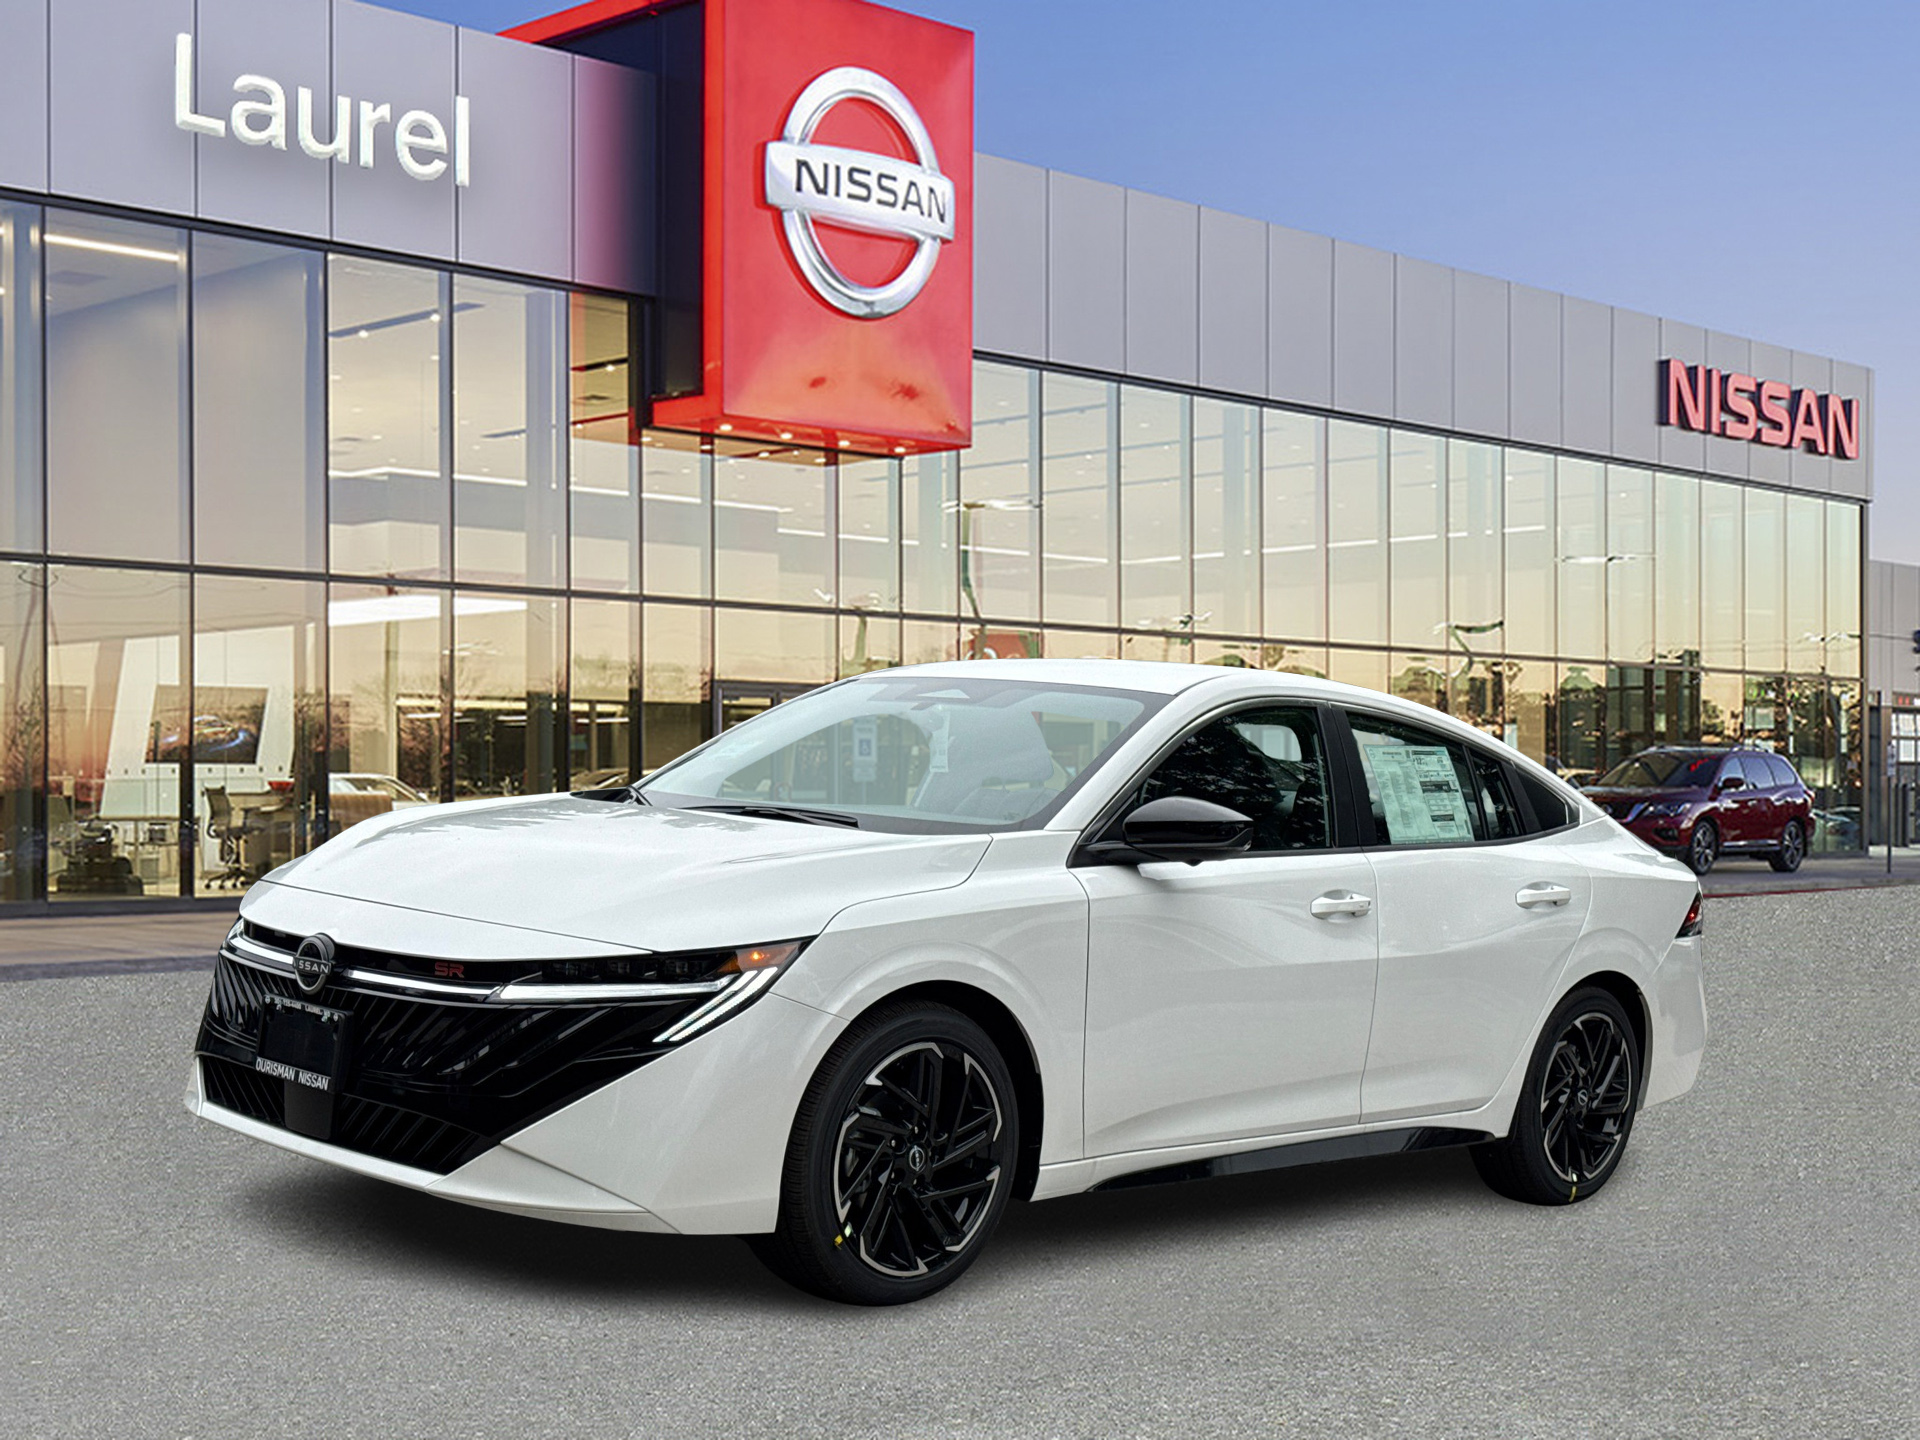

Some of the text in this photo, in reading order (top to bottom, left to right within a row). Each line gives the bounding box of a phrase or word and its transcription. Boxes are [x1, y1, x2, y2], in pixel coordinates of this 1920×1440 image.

[175, 32, 469, 188] Laurel
[795, 158, 946, 223] NISSAN
[1656, 358, 1859, 460] NISSAN
[435, 961, 464, 978] SR
[256, 1058, 329, 1090] OURISMAN NISSAN
